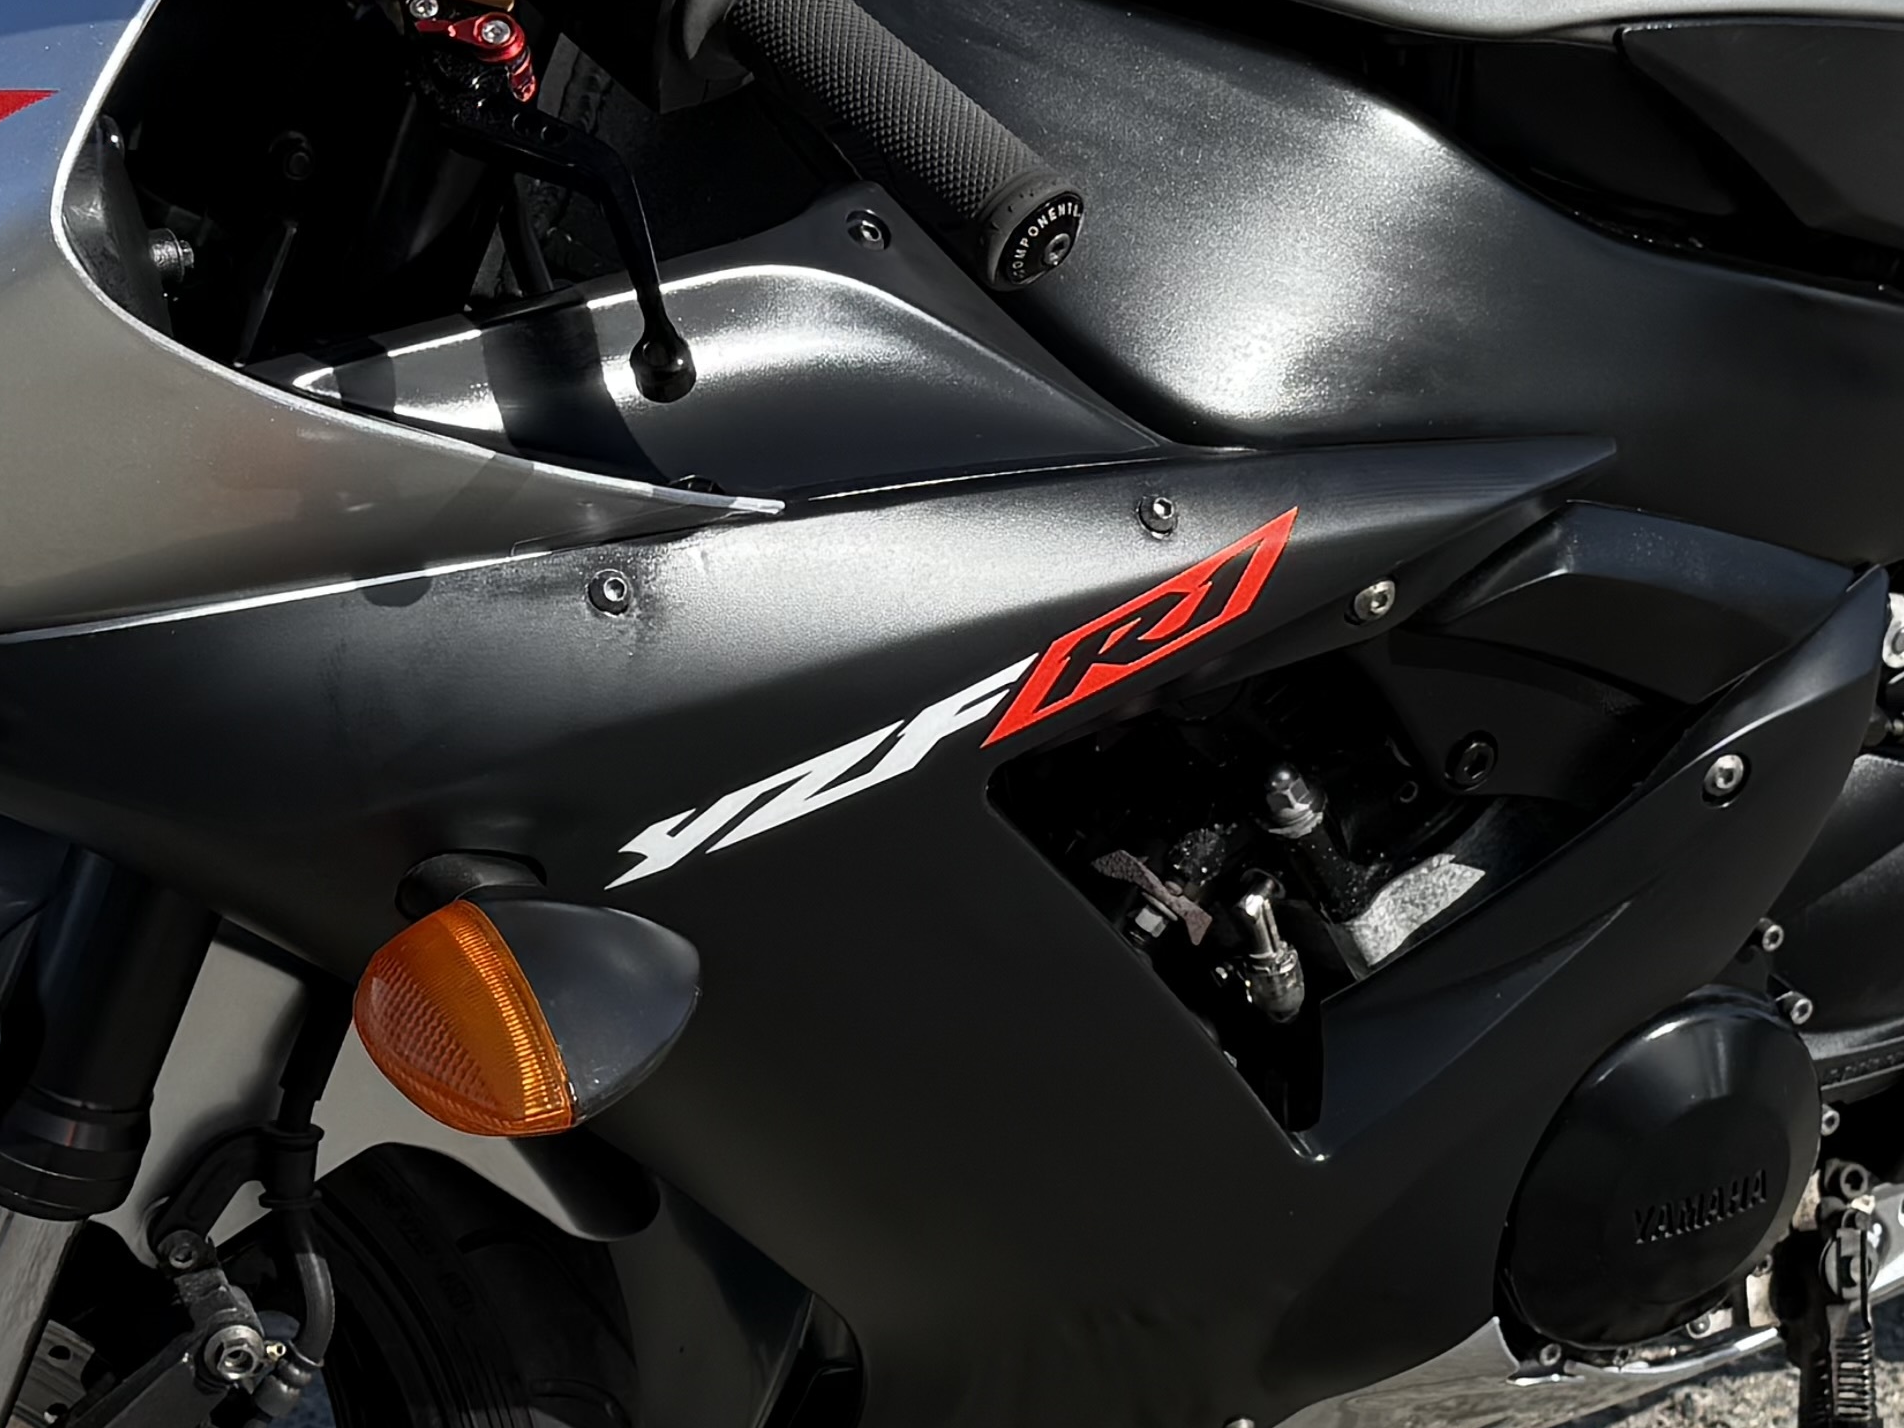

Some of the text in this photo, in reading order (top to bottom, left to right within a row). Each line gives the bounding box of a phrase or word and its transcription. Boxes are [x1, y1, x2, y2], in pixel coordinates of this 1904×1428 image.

[602, 505, 1299, 890] YZF R1
[1632, 1168, 1769, 1245] YAMAHA
